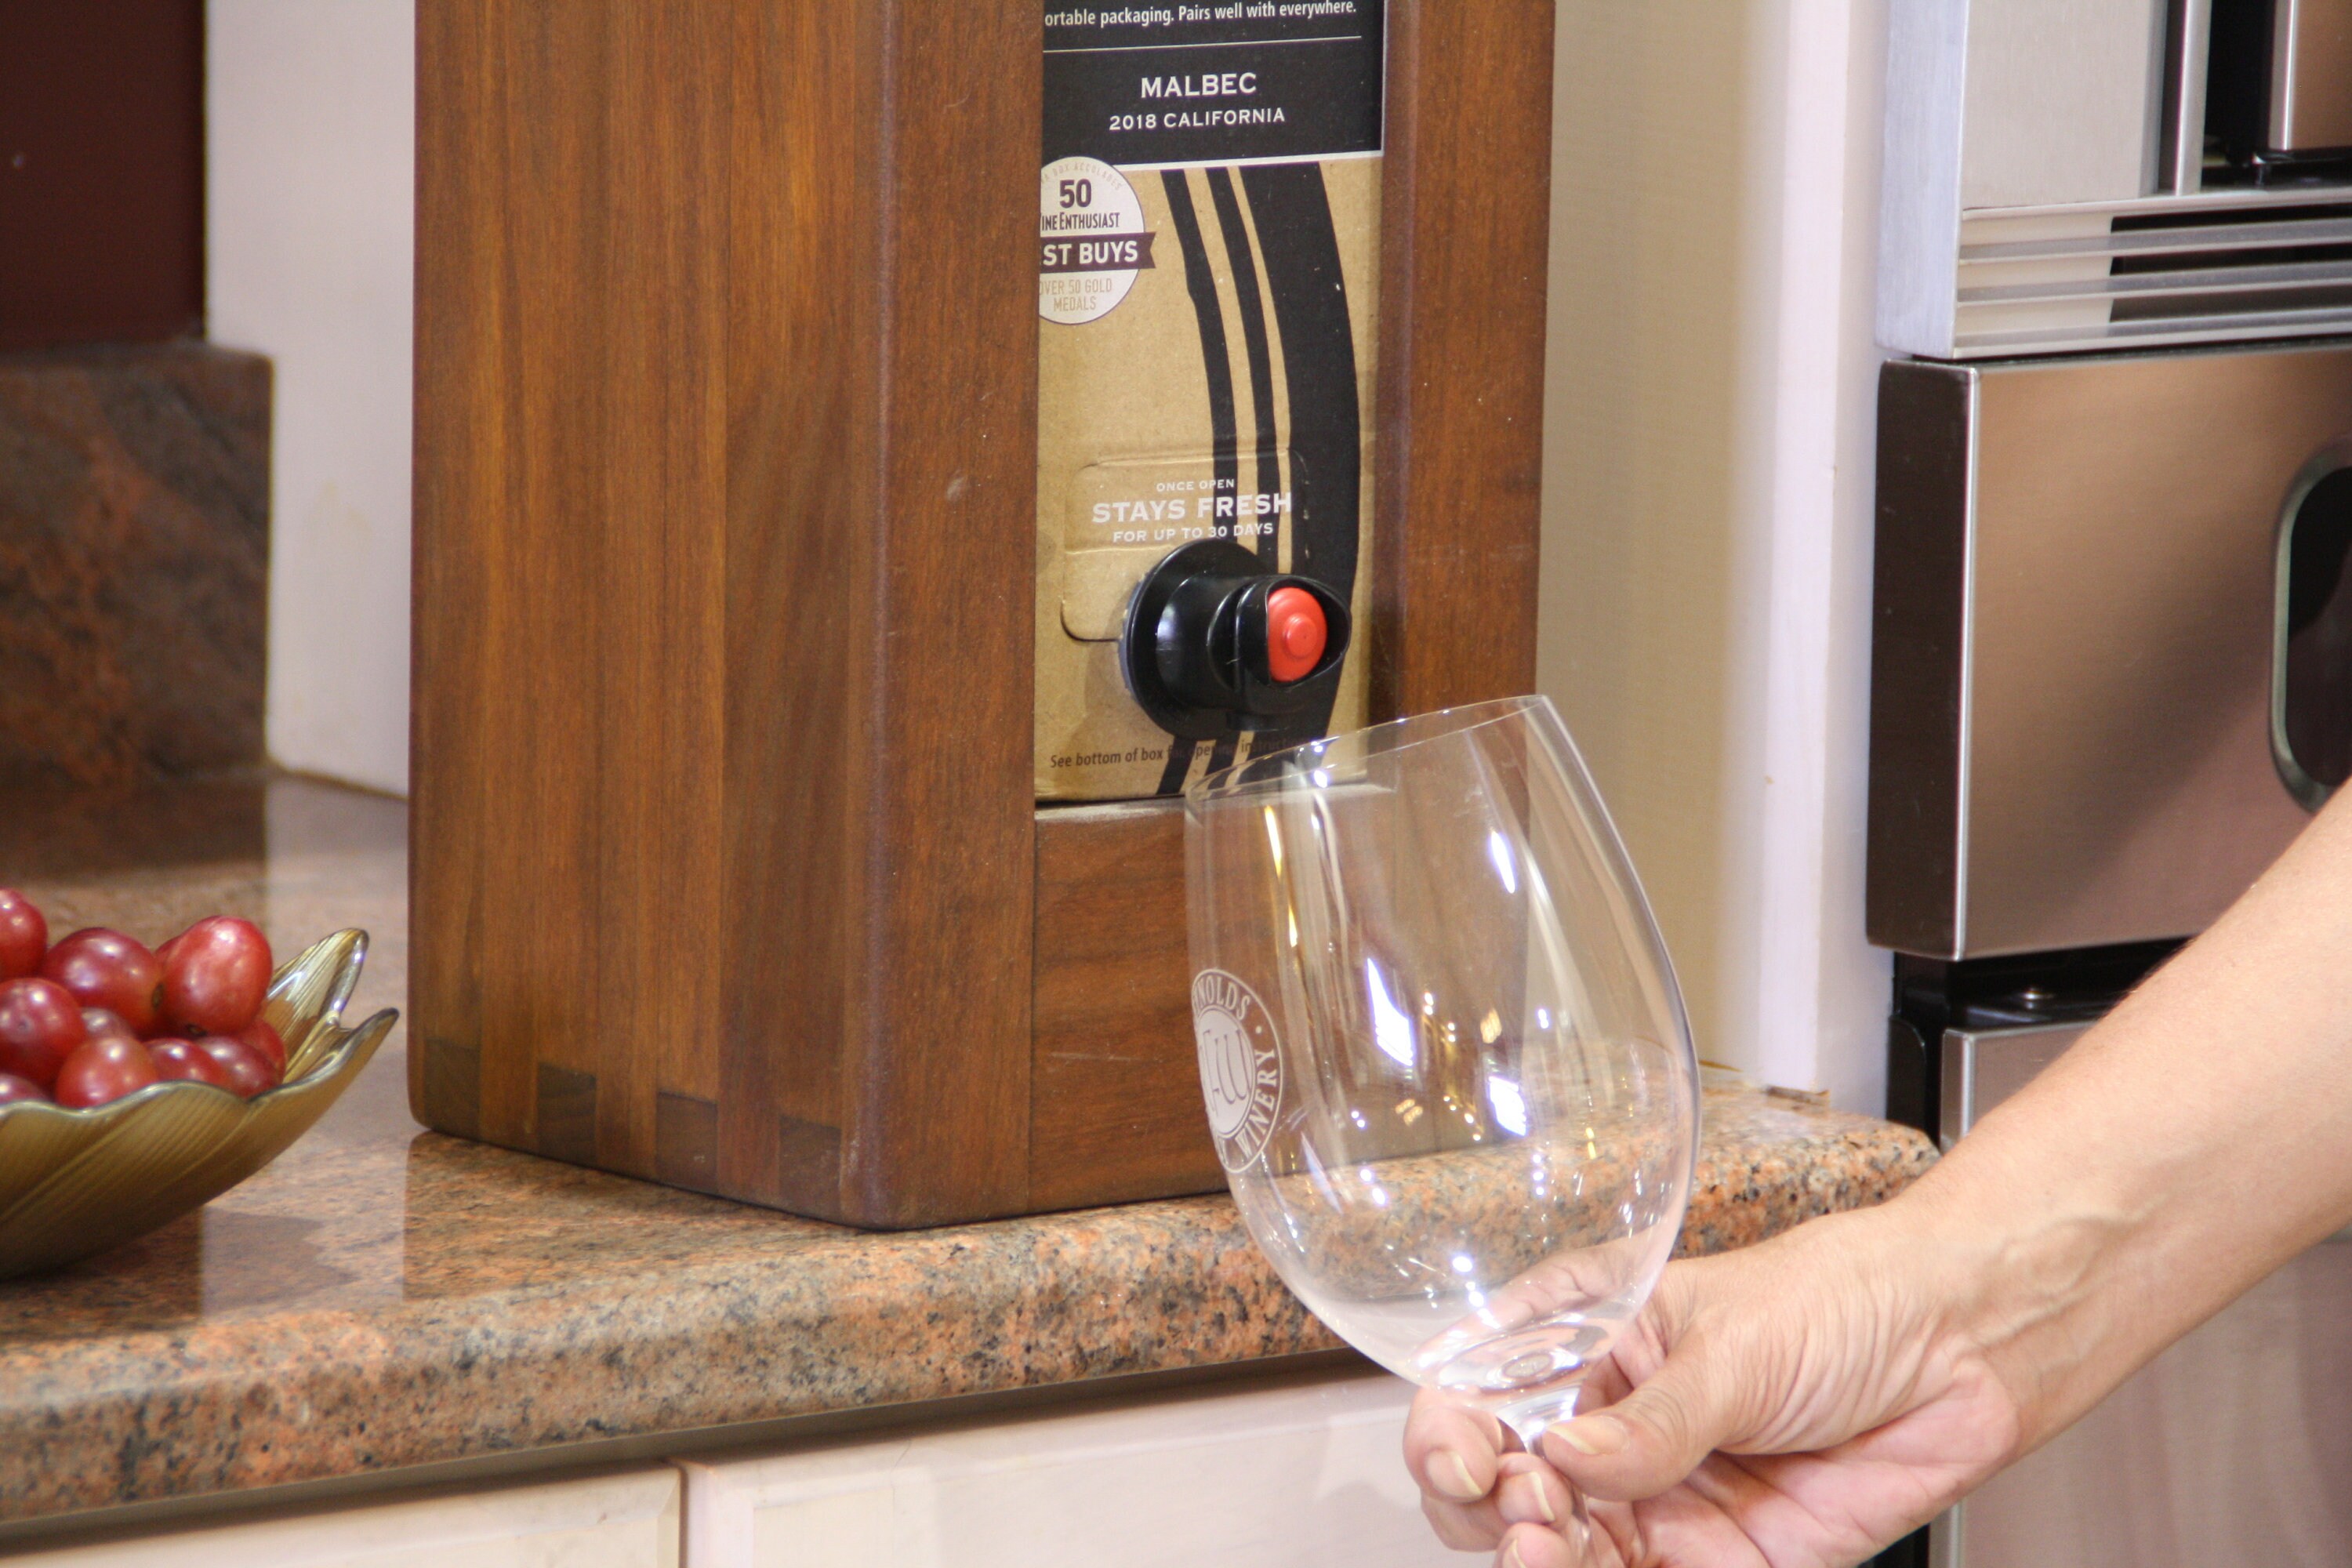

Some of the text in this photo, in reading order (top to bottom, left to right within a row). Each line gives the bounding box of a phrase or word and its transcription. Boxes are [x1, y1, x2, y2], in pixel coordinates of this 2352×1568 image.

[1101, 6, 1174, 28] packaging.
[1178, 5, 1210, 20] Pairs
[1215, 2, 1242, 19] well
[1247, 1, 1276, 17] with
[1279, 0, 1356, 19] everywhere.
[1141, 72, 1257, 98] MALBEC
[1109, 107, 1285, 131] 2018 CALIFORNIA
[1059, 178, 1092, 209] 50
[1040, 214, 1057, 230] INE
[1040, 240, 1138, 266] ST BUYS
[1069, 279, 1081, 294] 50
[1085, 278, 1112, 293] GOLD
[1053, 296, 1097, 312] MEDALS
[1156, 478, 1236, 492] ONCE OPEN
[1091, 492, 1292, 524] STAYS FRESH
[1112, 522, 1273, 543] FOR UP TO 30 DAYS
[1050, 754, 1072, 768] See
[1076, 752, 1121, 766] bottom
[1125, 748, 1138, 762] of
[1141, 747, 1163, 761] box
[1234, 1048, 1278, 1161] WINERY
